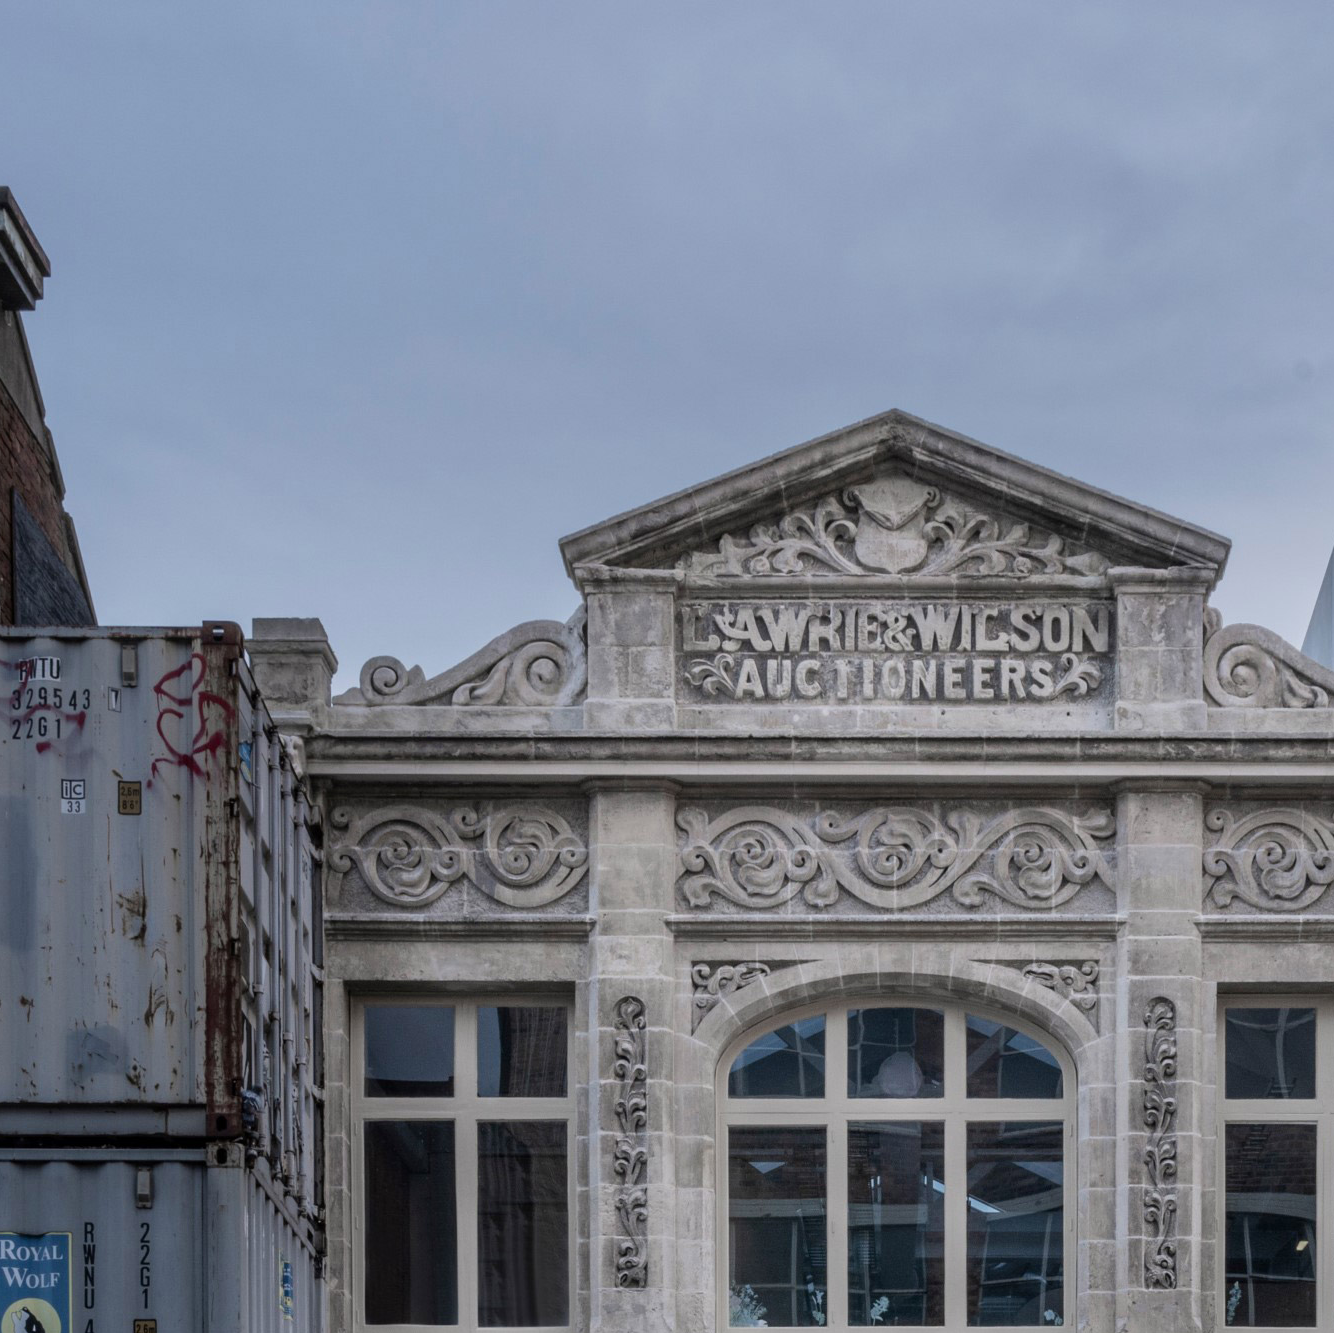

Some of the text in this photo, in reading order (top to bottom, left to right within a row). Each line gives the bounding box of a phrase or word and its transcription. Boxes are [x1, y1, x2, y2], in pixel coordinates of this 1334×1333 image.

[734, 657, 1053, 699] AUCTIONEERS
[12, 687, 91, 710] 329543
[12, 717, 61, 740] 22G1
[67, 801, 81, 813] 33
[83, 1222, 96, 1310] RWNU
[139, 1222, 151, 1310] 22G1
[1, 1267, 61, 1289] WOLF
